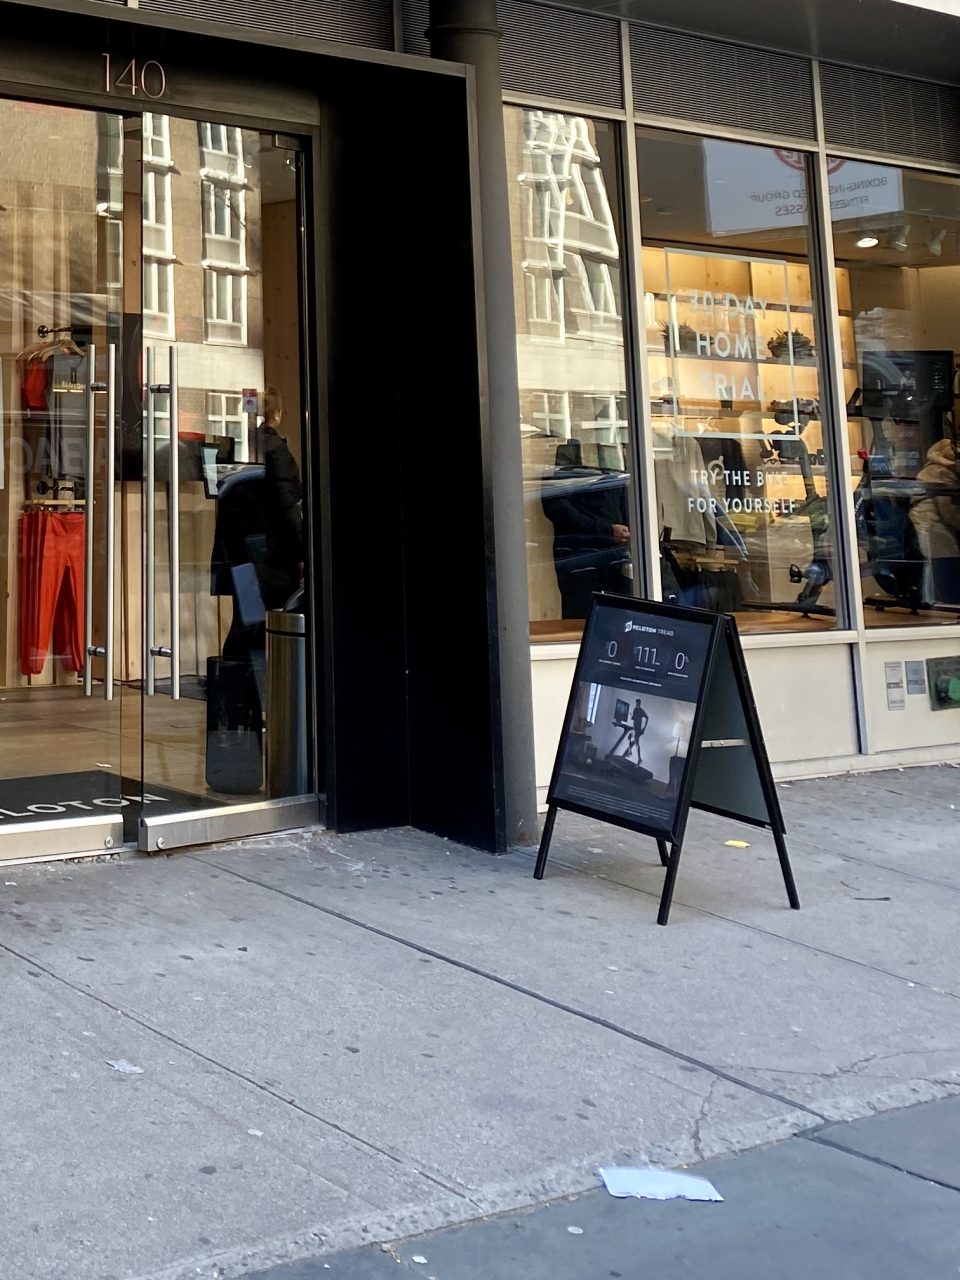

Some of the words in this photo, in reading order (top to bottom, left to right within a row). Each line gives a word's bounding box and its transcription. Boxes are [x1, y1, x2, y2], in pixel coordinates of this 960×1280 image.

[101, 52, 166, 99] 140
[696, 331, 767, 360] HOME
[700, 370, 767, 401] TRIAL
[690, 469, 719, 486] TRY
[724, 470, 751, 486] THE
[757, 471, 788, 487] BIKE
[688, 497, 717, 513] FOR
[723, 497, 797, 514] YOURSELF
